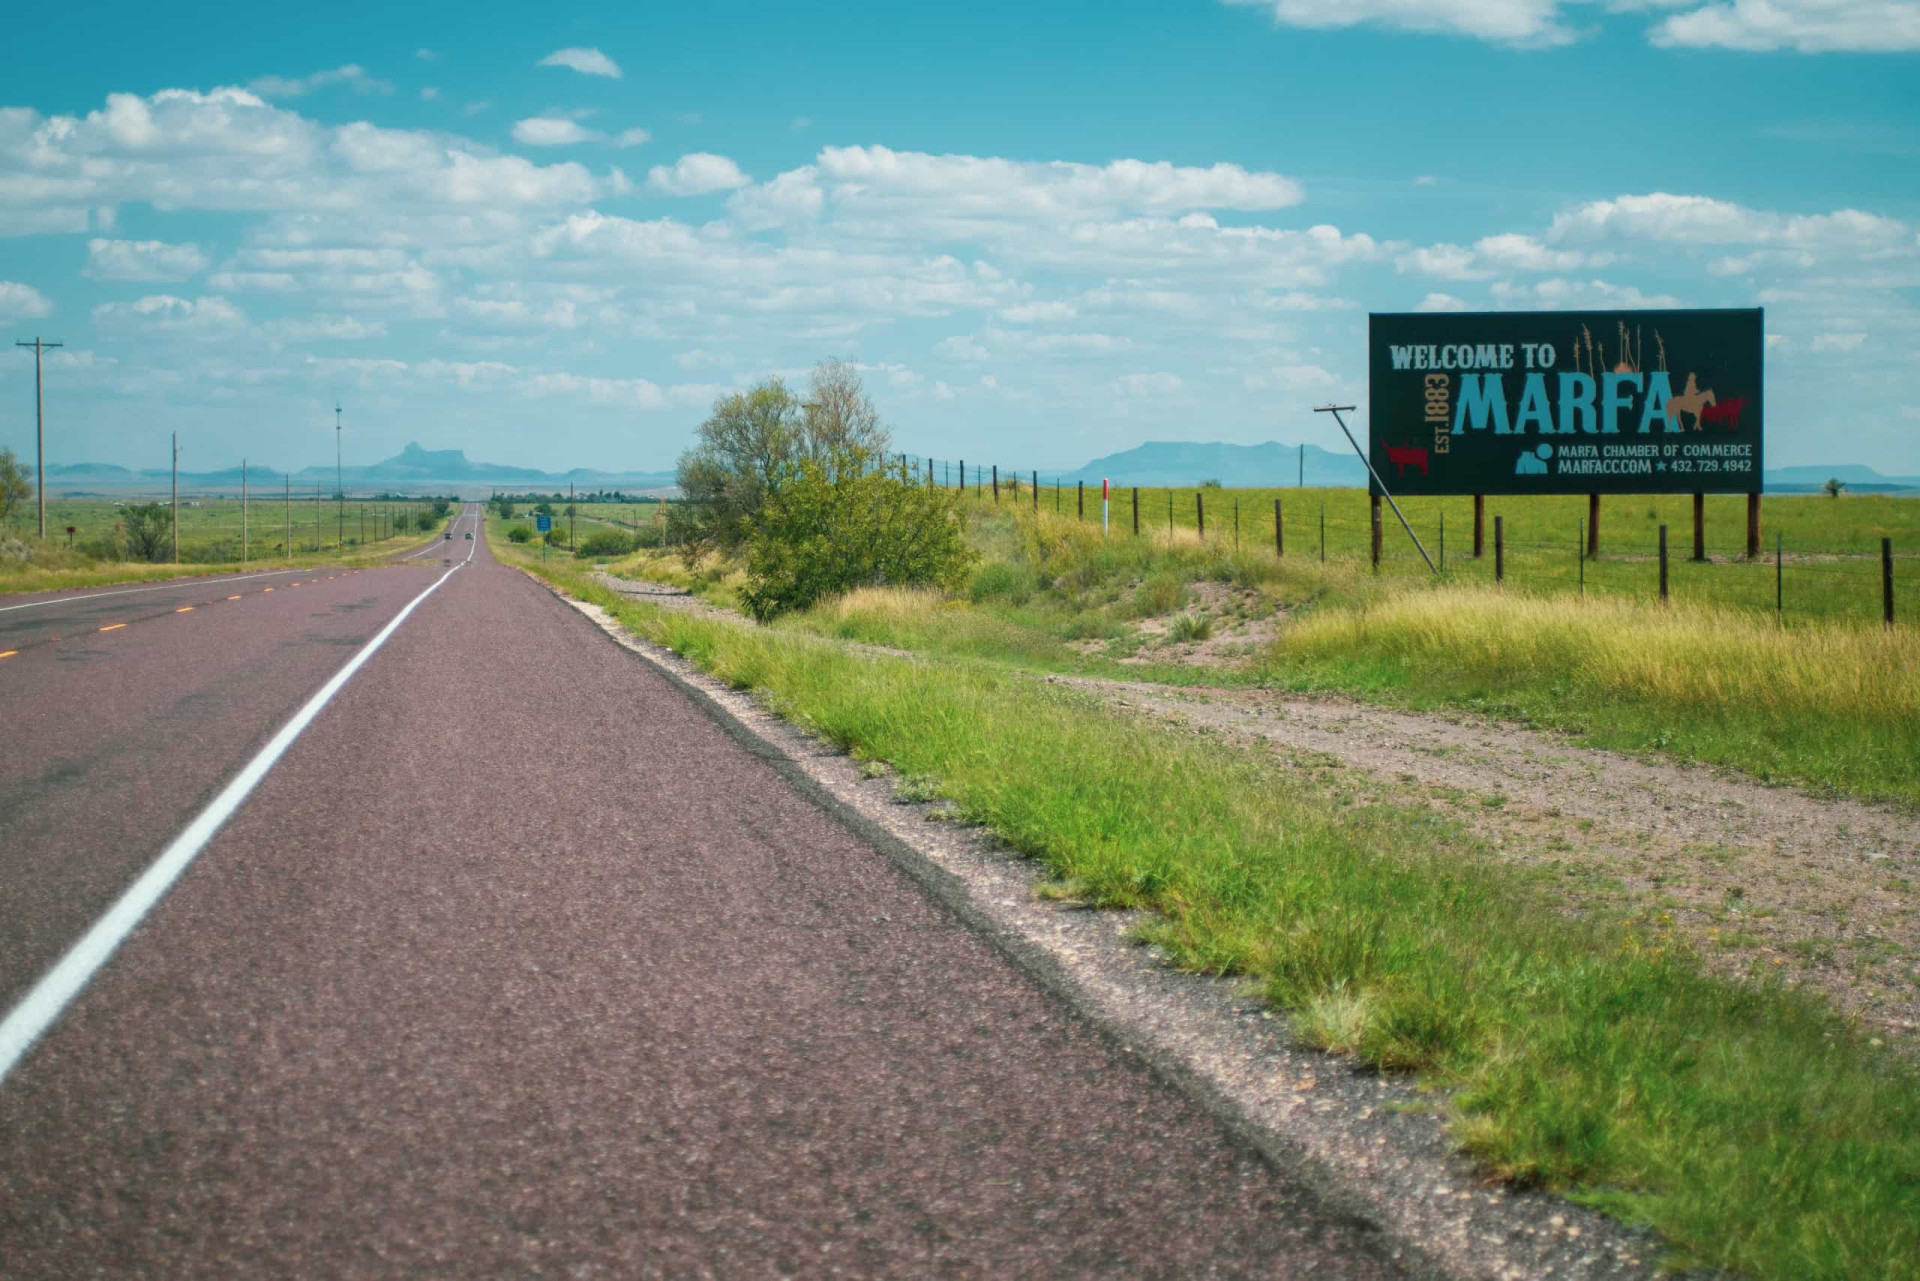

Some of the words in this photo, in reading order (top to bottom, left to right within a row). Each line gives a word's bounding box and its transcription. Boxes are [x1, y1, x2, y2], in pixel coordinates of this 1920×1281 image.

[1390, 344, 1514, 370] WELCOME
[1522, 343, 1556, 369] TO
[1451, 371, 1682, 435] MARFA
[1558, 445, 1598, 457] MARFA
[1603, 445, 1659, 457] CHAMBER
[1663, 445, 1679, 456] OF
[1683, 444, 1752, 456] COMMERCE
[1671, 460, 1752, 472] 432.729.4942
